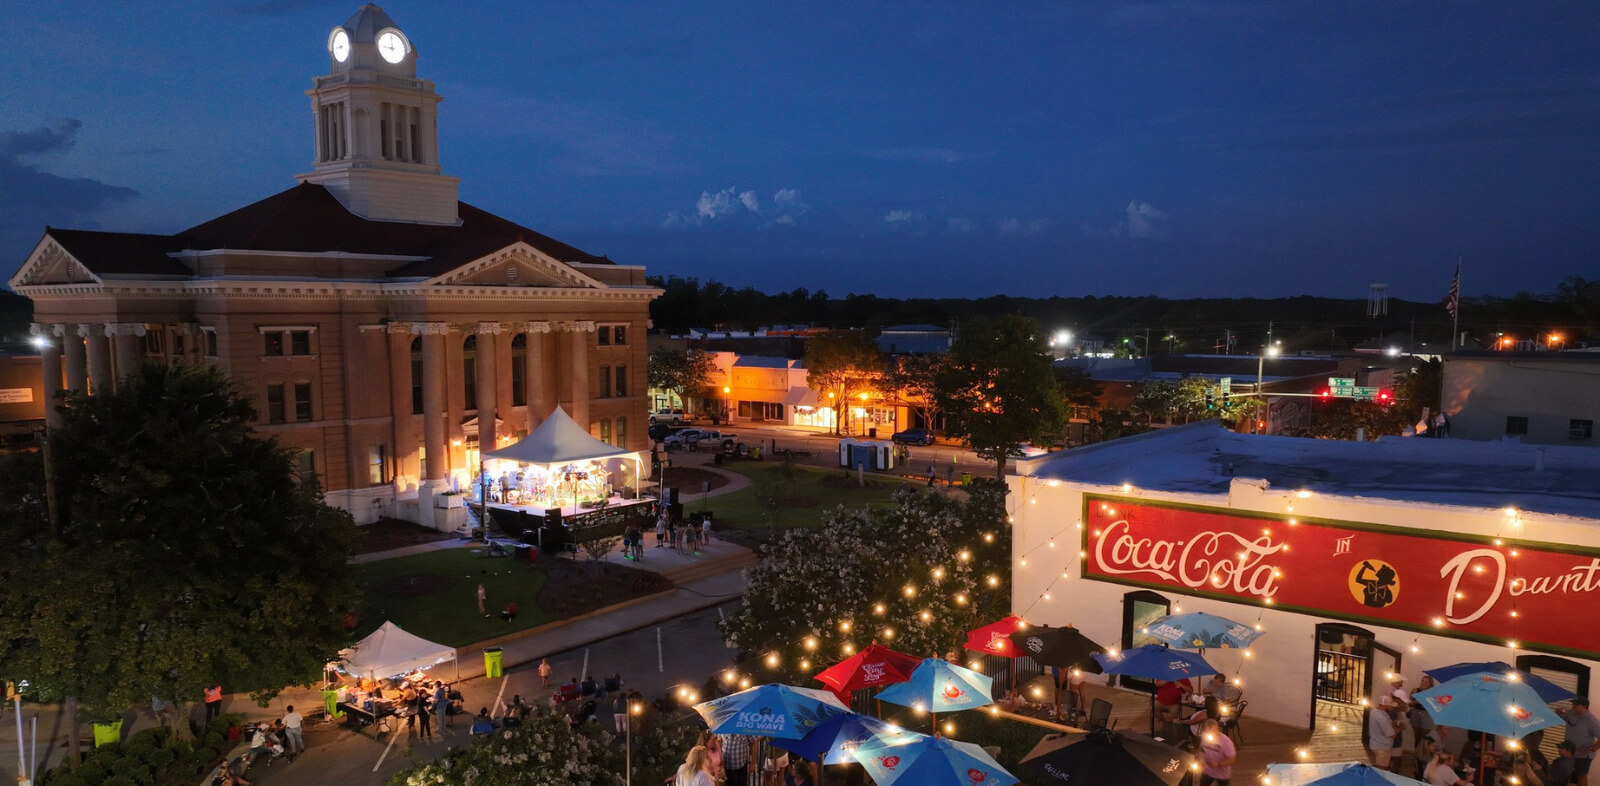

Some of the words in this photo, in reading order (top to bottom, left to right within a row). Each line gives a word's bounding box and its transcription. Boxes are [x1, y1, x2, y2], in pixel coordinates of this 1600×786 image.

[1334, 536, 1352, 555] IN
[1095, 520, 1283, 597] Coca-Cola
[1440, 549, 1600, 624] Downt
[736, 721, 754, 729] BIG
[757, 722, 786, 730] WAVE
[739, 711, 785, 723] KONA
